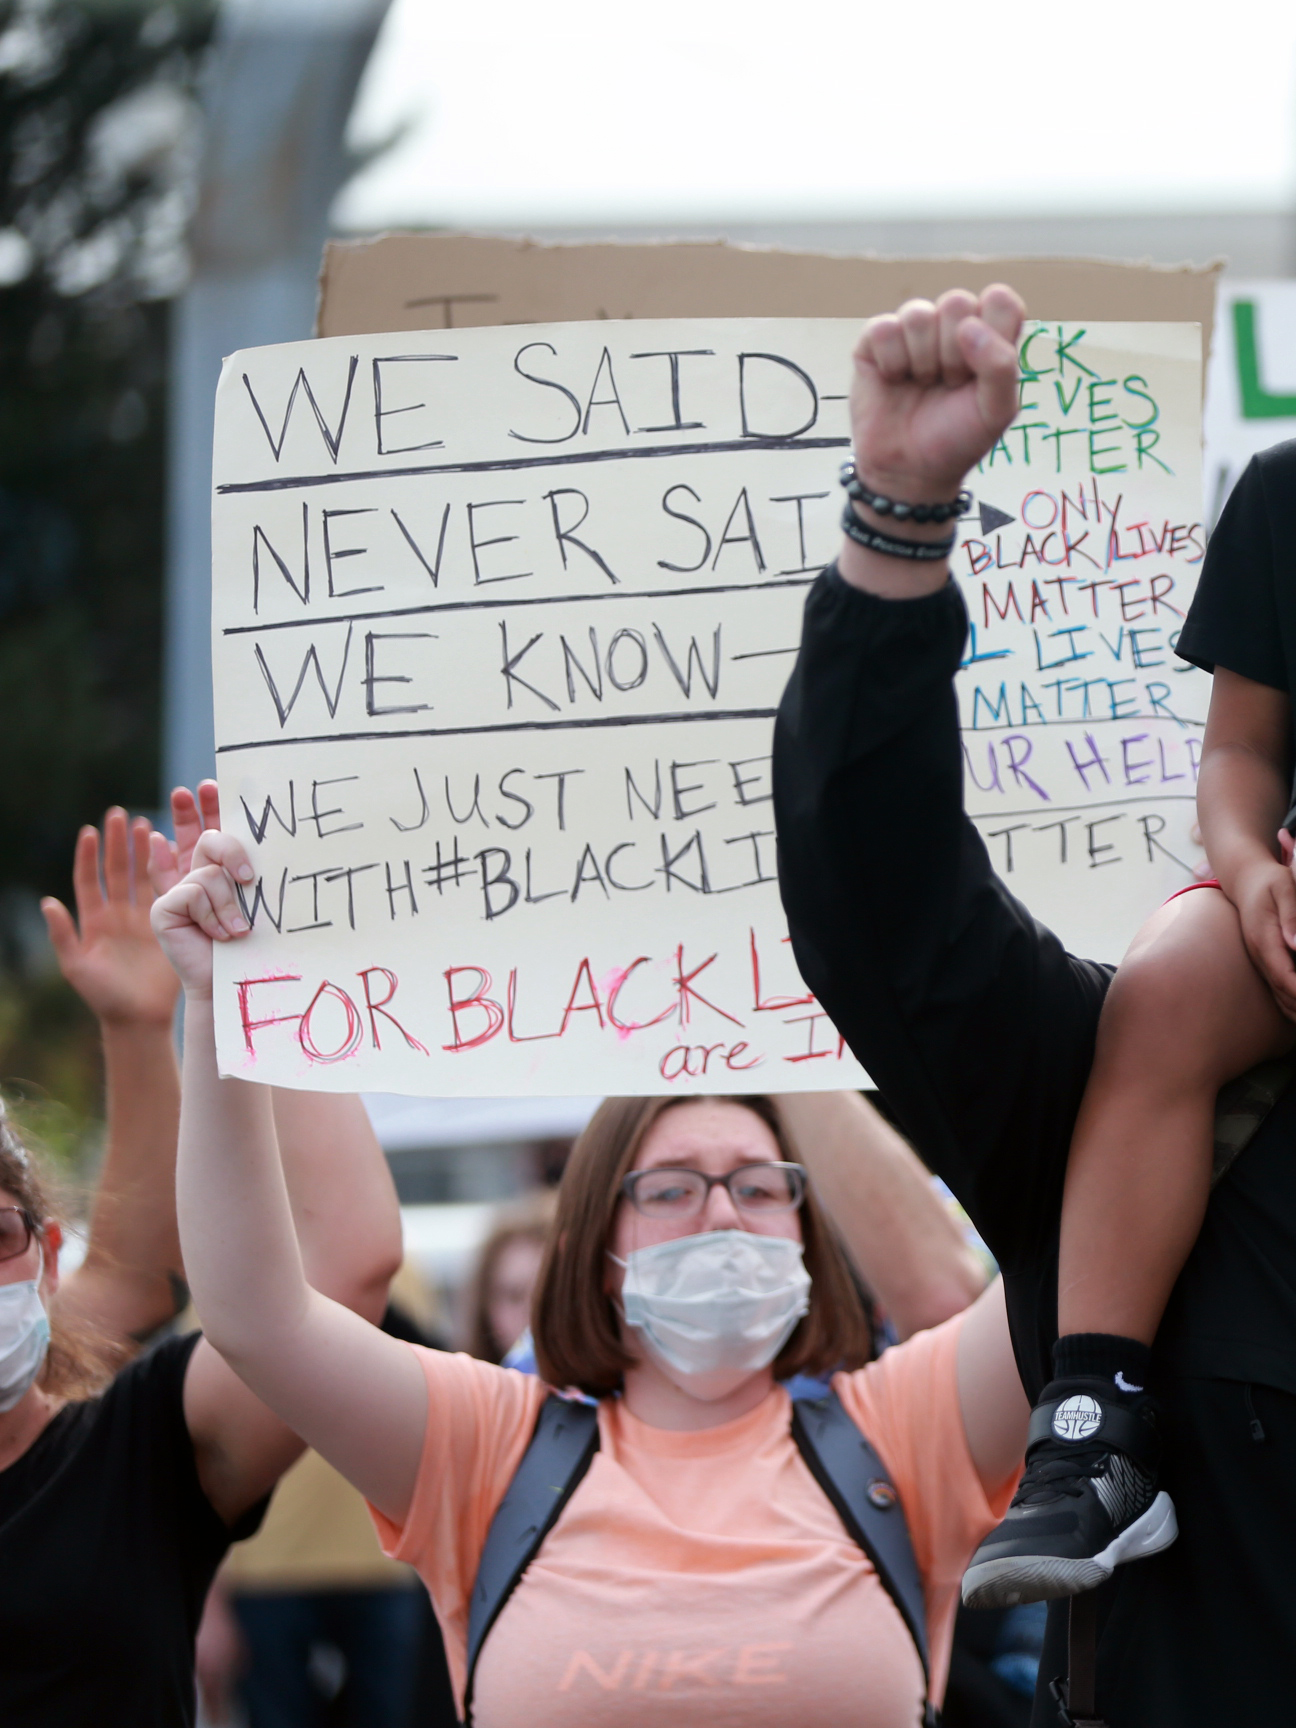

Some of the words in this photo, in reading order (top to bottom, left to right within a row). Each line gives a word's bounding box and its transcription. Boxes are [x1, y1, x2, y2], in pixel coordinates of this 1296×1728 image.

[1018, 325, 1101, 381] CK
[241, 354, 459, 465] WE
[976, 421, 1178, 477] ATTER
[252, 487, 621, 615] NEVER
[656, 483, 832, 577] SAI
[960, 531, 1104, 577] BLACK
[1107, 519, 1206, 564] LIVES
[982, 572, 1188, 629] MATTER
[254, 620, 440, 729] WE
[973, 677, 1189, 730] MATTER
[959, 733, 1052, 802] UR
[239, 776, 364, 845] WE
[389, 766, 586, 832] JUST
[624, 755, 773, 821] NEE
[986, 812, 1197, 877] TTER
[233, 965, 430, 1064] FOR
[441, 943, 747, 1053] BLACK
[659, 1038, 766, 1082] are
[557, 1641, 793, 1692] NIKE
